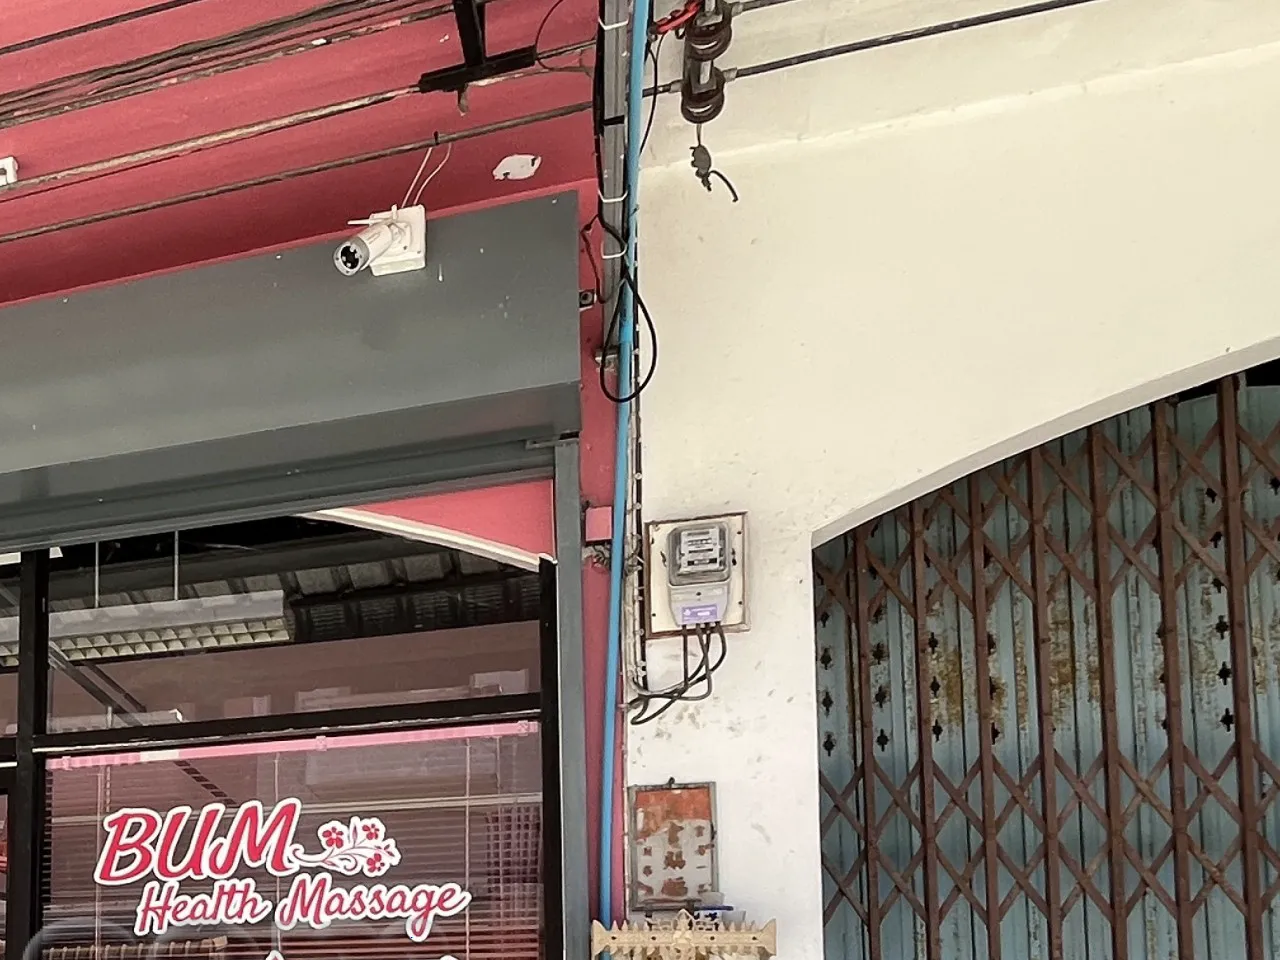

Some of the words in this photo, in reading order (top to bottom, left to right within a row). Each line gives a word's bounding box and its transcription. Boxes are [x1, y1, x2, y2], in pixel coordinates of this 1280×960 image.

[96, 798, 300, 884] BUM
[135, 880, 271, 935] Health
[276, 873, 471, 942] Massage
